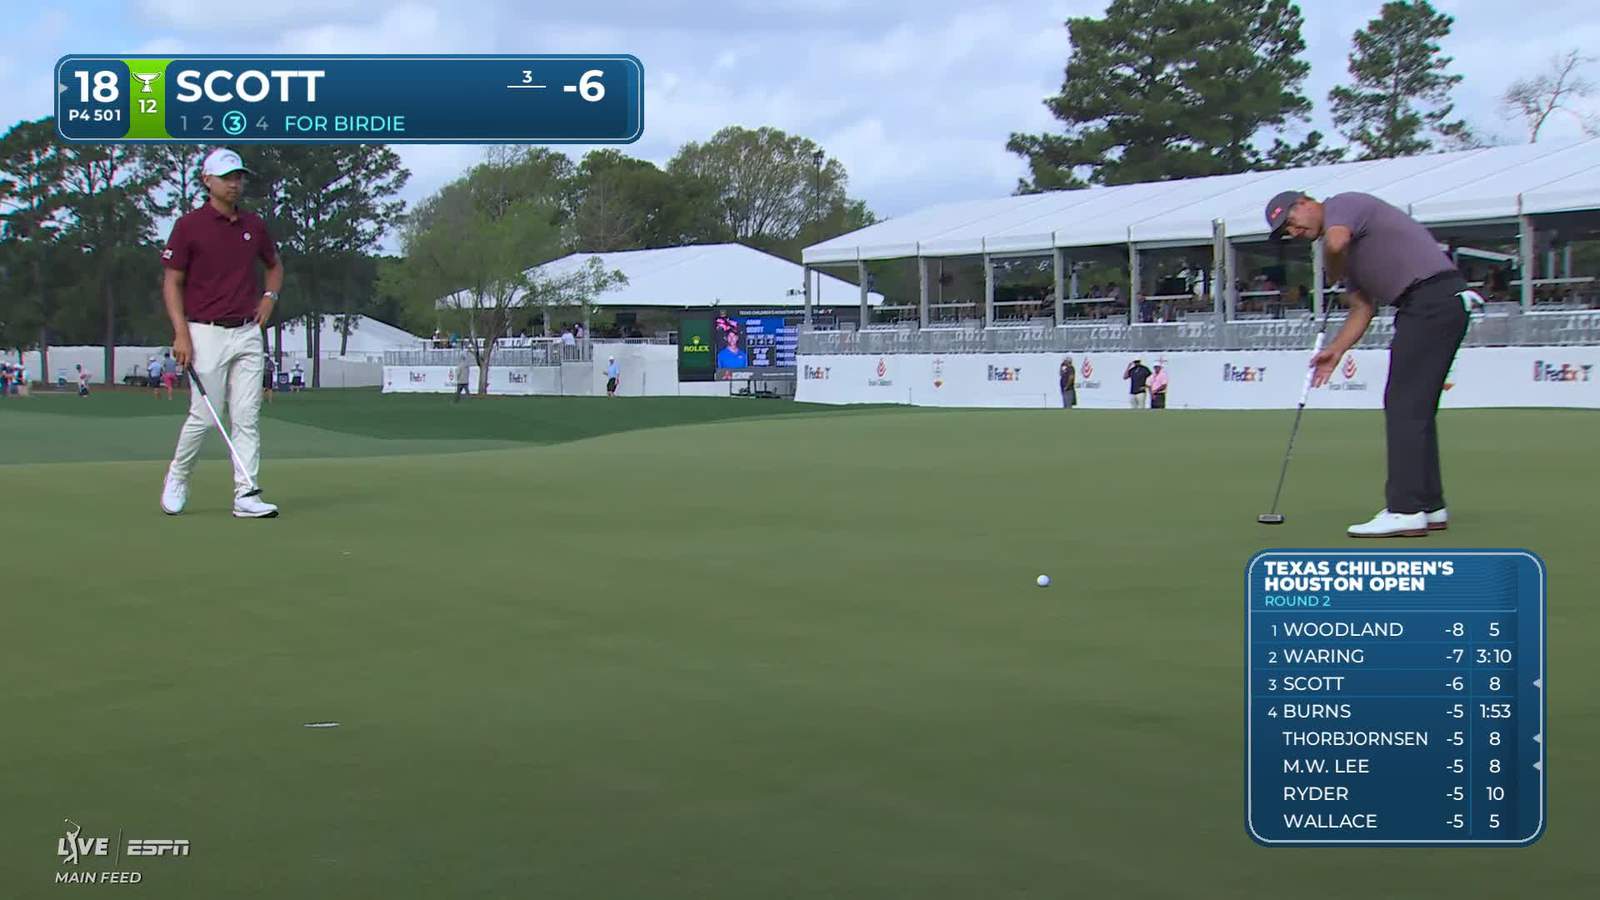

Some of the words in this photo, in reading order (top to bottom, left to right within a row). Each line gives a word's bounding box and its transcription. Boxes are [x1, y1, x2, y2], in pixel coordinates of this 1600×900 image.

[683, 345, 710, 353] ROLEX
[1231, 366, 1256, 382] FedEx
[1544, 364, 1578, 382] FedEx
